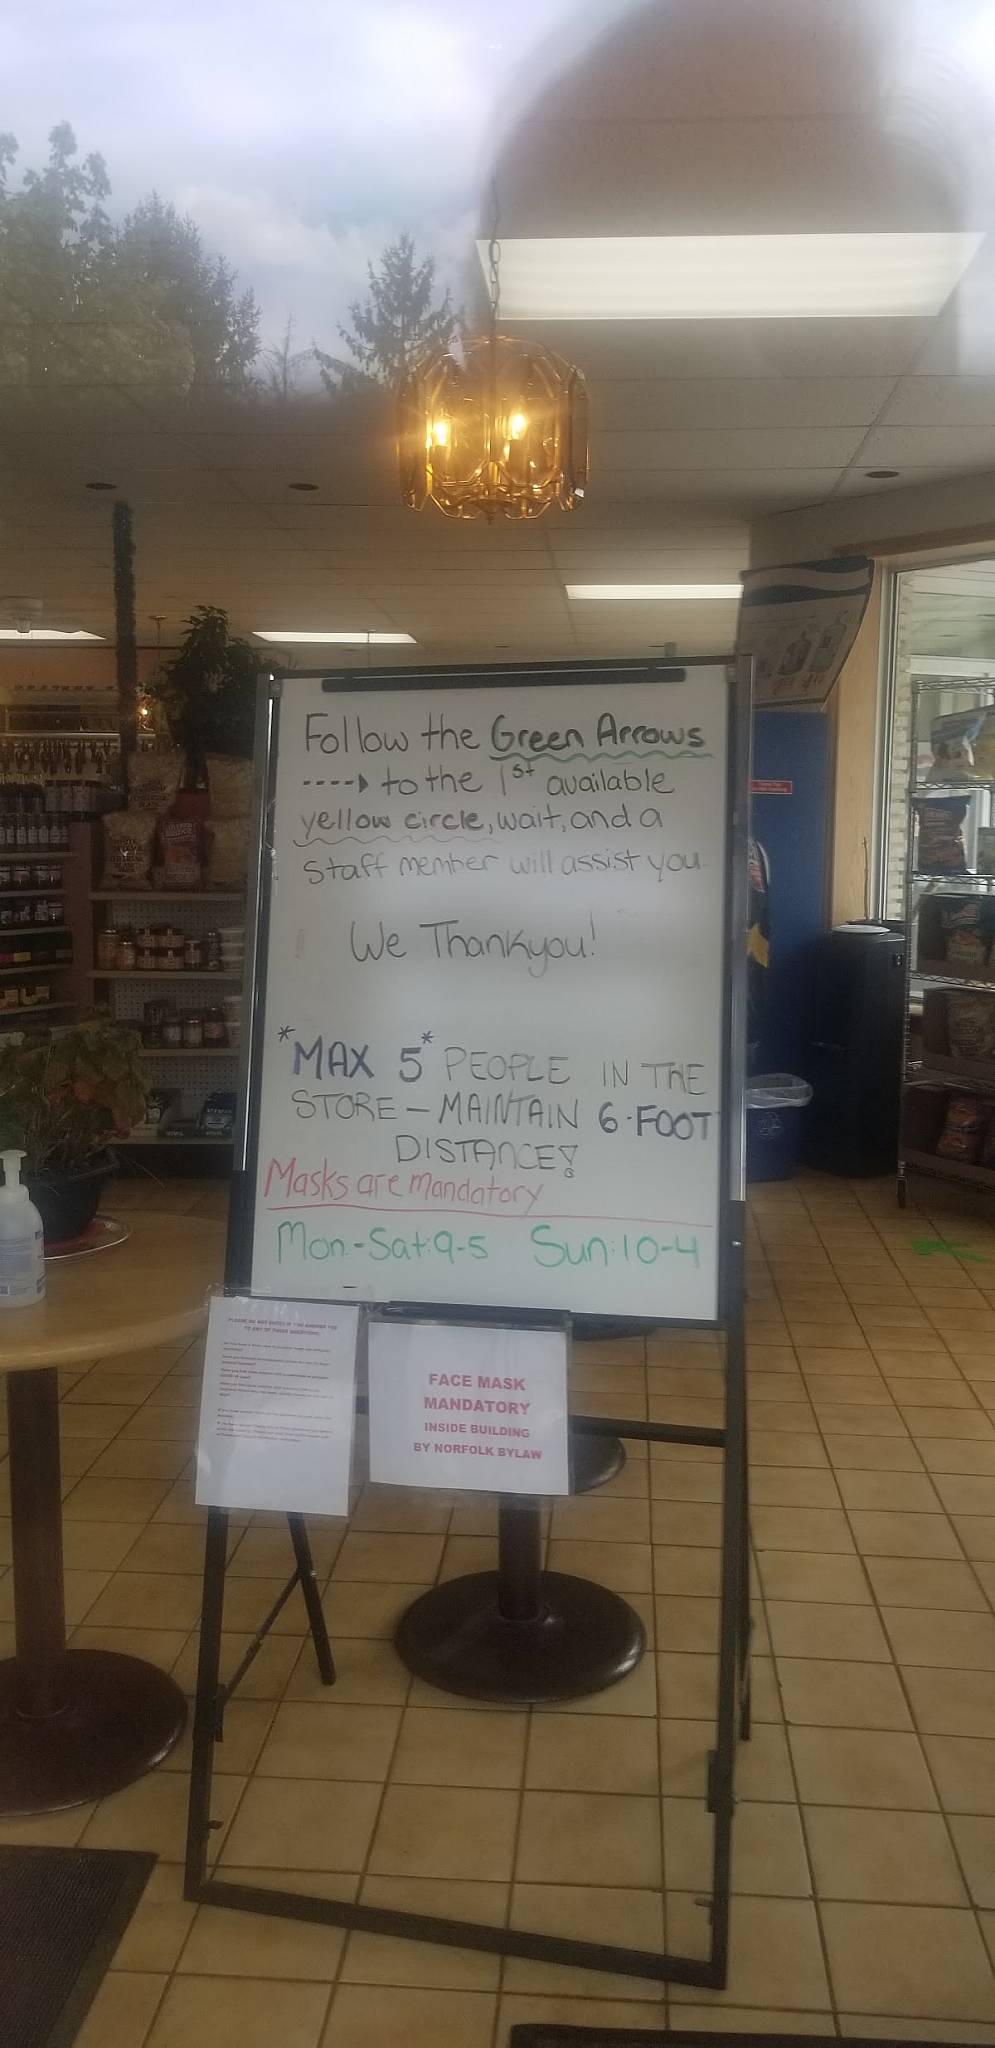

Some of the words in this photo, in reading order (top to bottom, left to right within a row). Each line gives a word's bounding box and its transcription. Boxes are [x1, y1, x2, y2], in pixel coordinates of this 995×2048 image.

[306, 713, 409, 754] Follow
[421, 713, 480, 751] the
[491, 713, 584, 751] Green
[597, 713, 706, 748] Arrows
[381, 765, 418, 795] to
[425, 765, 483, 793] the
[546, 769, 676, 797] available
[301, 808, 391, 840] yellow
[571, 806, 632, 830] and
[640, 810, 664, 830] a
[400, 852, 499, 876] member
[510, 850, 552, 875] will
[561, 849, 641, 875] assist
[351, 920, 407, 961] We
[445, 1046, 571, 1084] PEOPLE
[603, 1060, 628, 1088] IN
[291, 1089, 398, 1121] STORE
[438, 1092, 578, 1129] MAINTAIN
[264, 1157, 349, 1200] Masks
[357, 1173, 402, 1197] are
[429, 1373, 472, 1387] FACE
[477, 1375, 526, 1391] MASK
[424, 1397, 530, 1415] MANDATORY
[424, 1422, 467, 1433] INSIDE
[470, 1424, 530, 1438] BUILDING
[413, 1442, 430, 1452] BY
[434, 1444, 494, 1456] NORFOLK
[498, 1447, 542, 1459] BYLAW
